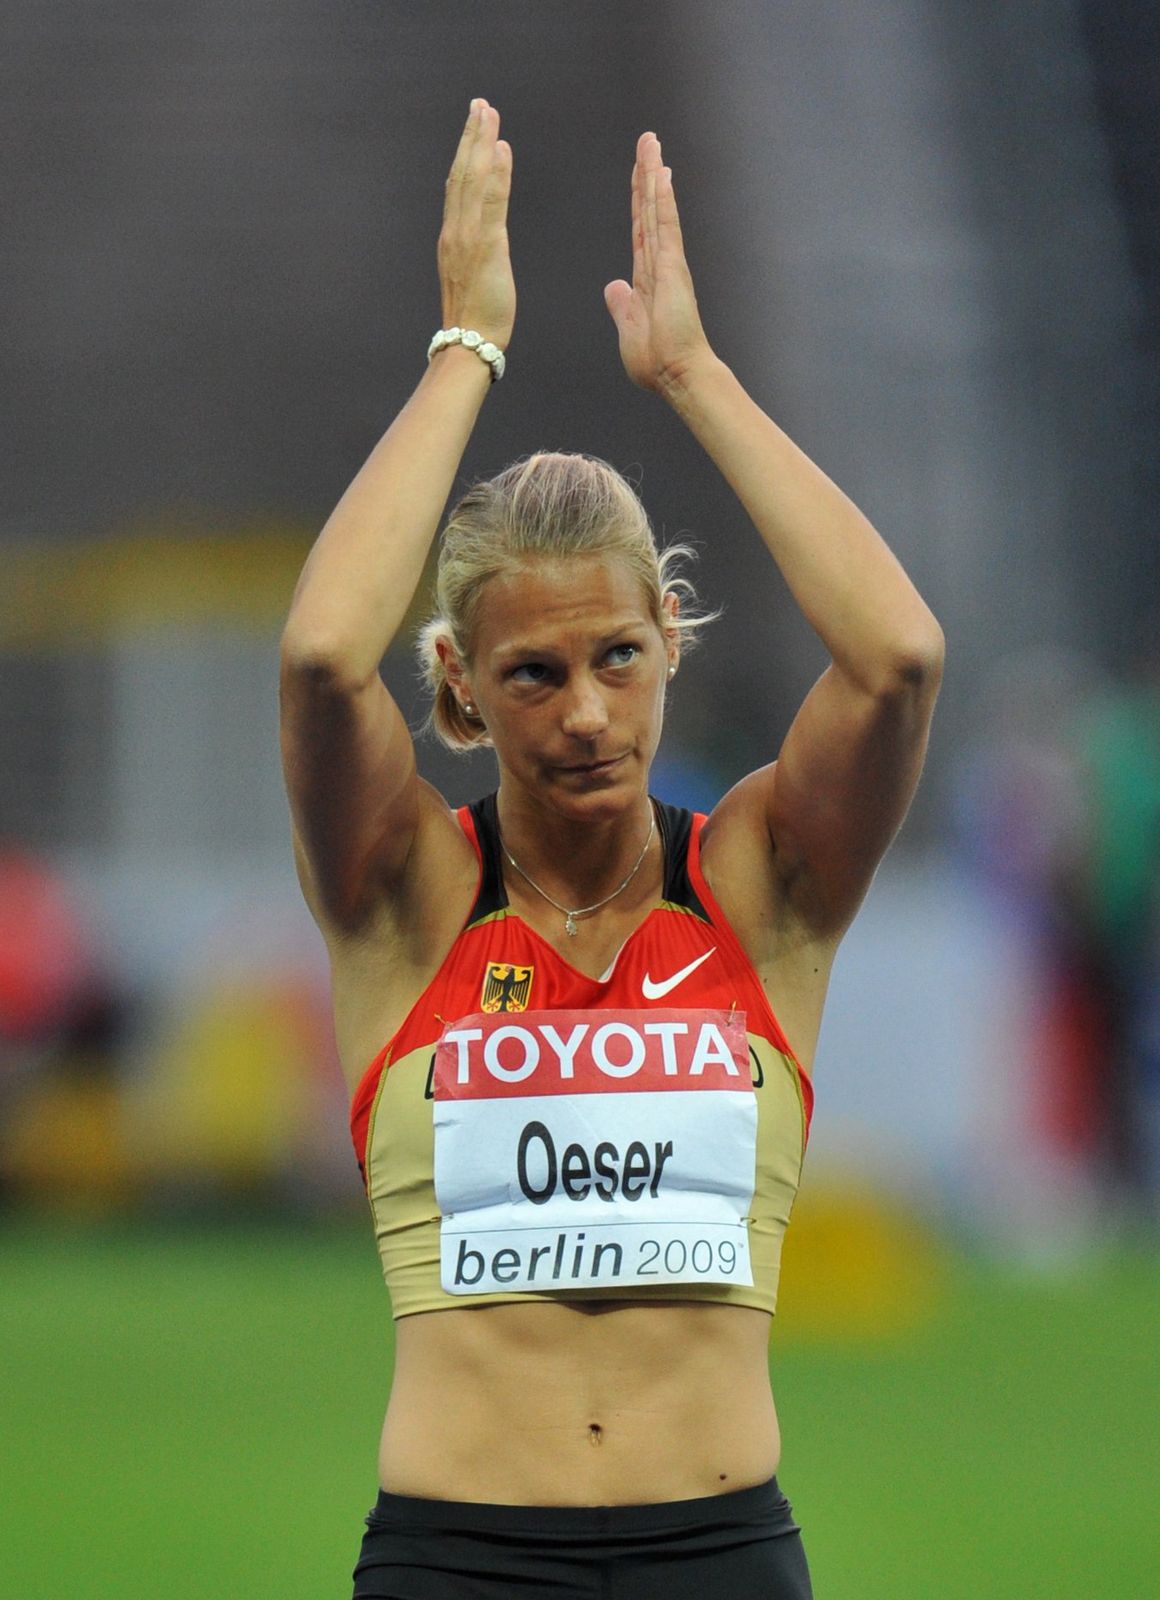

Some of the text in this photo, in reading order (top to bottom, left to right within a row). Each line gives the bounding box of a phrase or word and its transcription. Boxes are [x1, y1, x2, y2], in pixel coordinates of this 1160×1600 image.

[445, 1022, 740, 1084] TOYOTA
[517, 1121, 673, 1205] Oeser
[454, 1233, 737, 1286] berlin 2009
